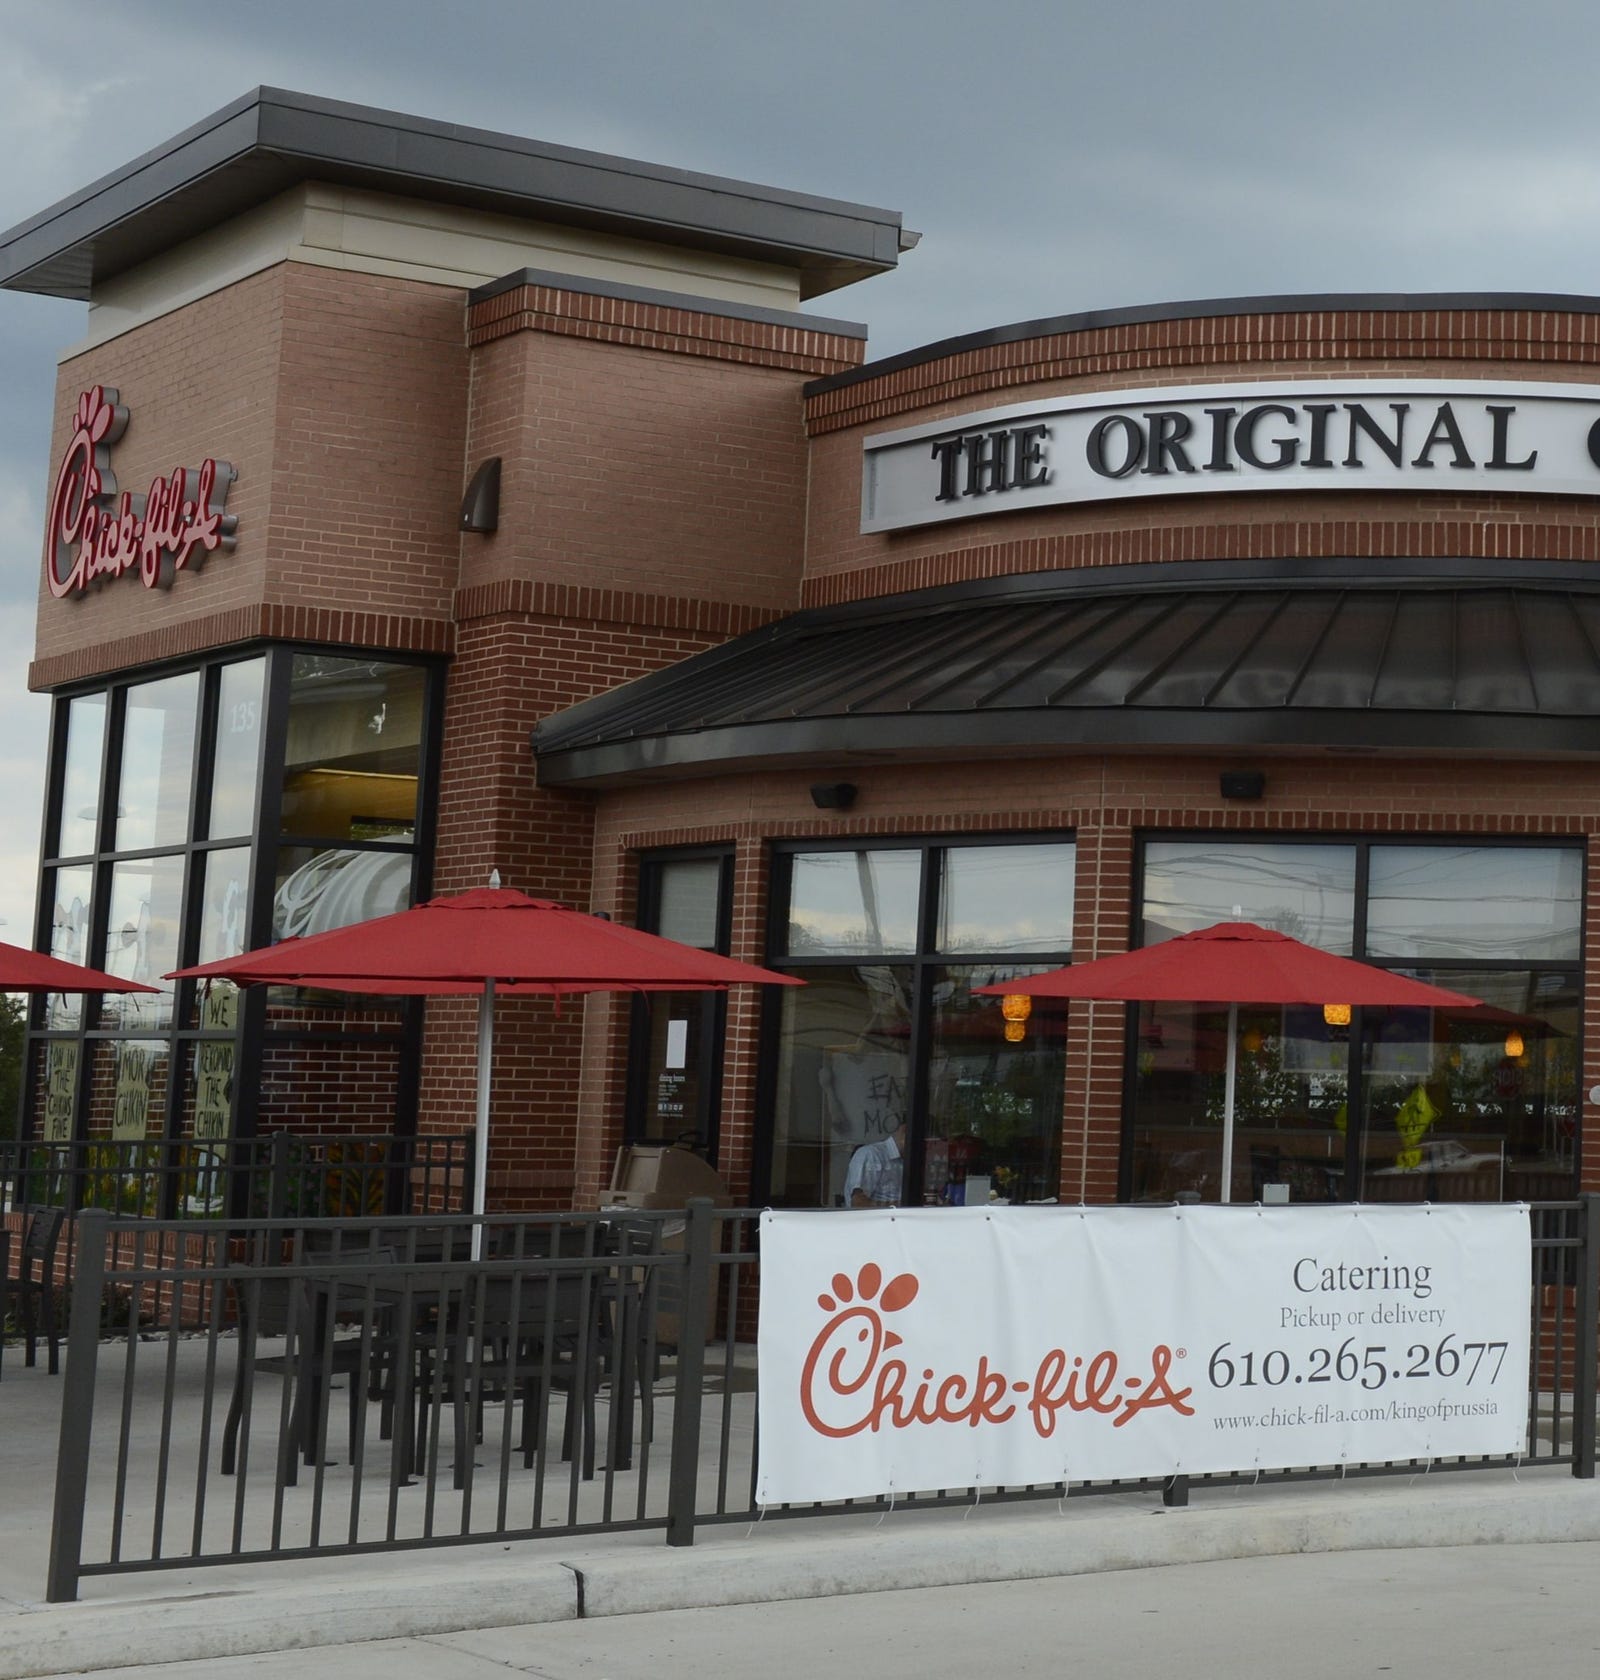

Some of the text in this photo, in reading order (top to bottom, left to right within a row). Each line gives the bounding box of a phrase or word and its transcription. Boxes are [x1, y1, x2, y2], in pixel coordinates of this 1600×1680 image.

[931, 424, 1050, 501] THE
[1086, 401, 1539, 478] ORIGINAL
[48, 429, 223, 598] Chick-fil-A
[230, 701, 256, 733] 135
[210, 996, 229, 1028] WE
[54, 1069, 71, 1093] THE
[121, 1048, 145, 1082] MOR
[116, 1089, 147, 1128] CHIKIN
[205, 1076, 221, 1107] THE
[1293, 1256, 1432, 1297] Catering
[1280, 1303, 1446, 1330] Pickup or delivery
[801, 1305, 1194, 1438] Chick-fil-A
[1208, 1333, 1509, 1390] 610.265.2677
[1213, 1400, 1499, 1430] www.chick-fil-a.com/kingofprussia
